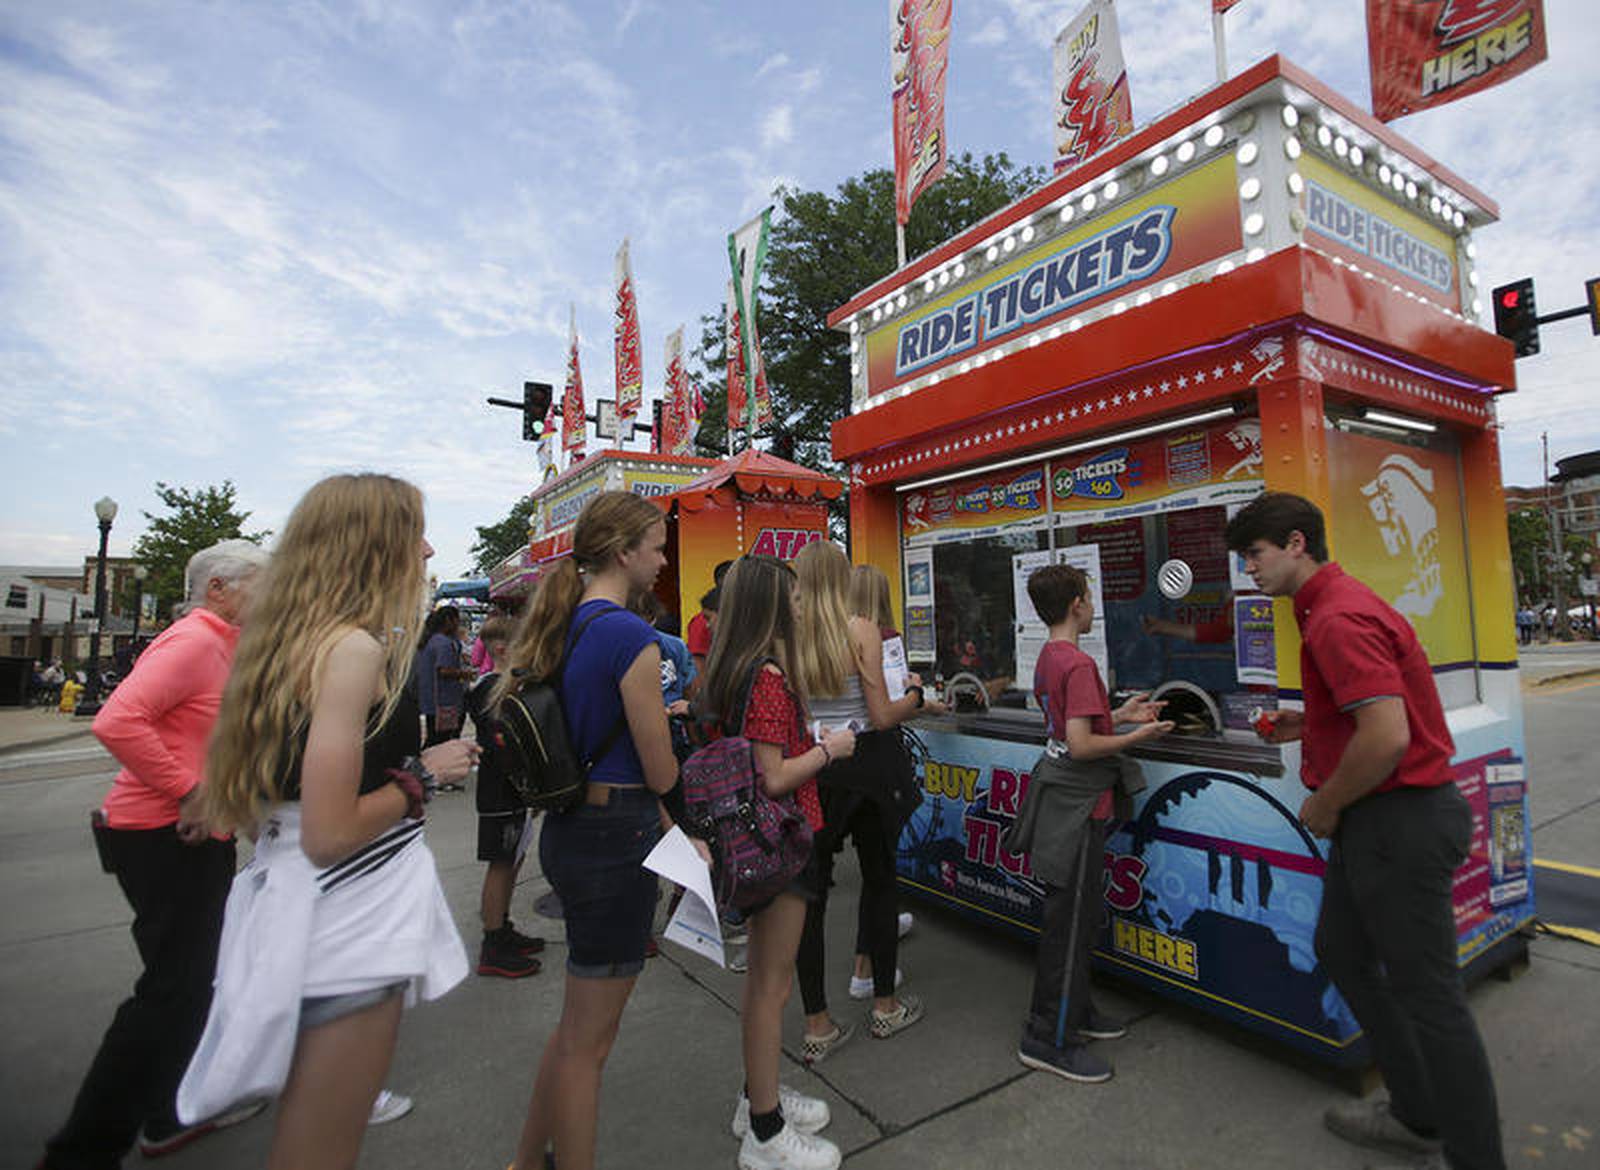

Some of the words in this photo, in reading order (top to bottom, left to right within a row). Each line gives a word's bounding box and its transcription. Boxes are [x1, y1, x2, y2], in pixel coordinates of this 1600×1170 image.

[1067, 13, 1099, 73] BUY
[1421, 10, 1533, 97] HERE
[1308, 186, 1366, 247] RIDE
[1372, 219, 1451, 288] TICKETS
[899, 301, 975, 369] RIDE
[984, 212, 1164, 331] TICKETS
[1055, 474, 1074, 492] 50
[1075, 456, 1128, 481] TICKETS
[1089, 479, 1113, 496] $60
[925, 761, 979, 803] BUY
[1114, 918, 1197, 977] HERE
